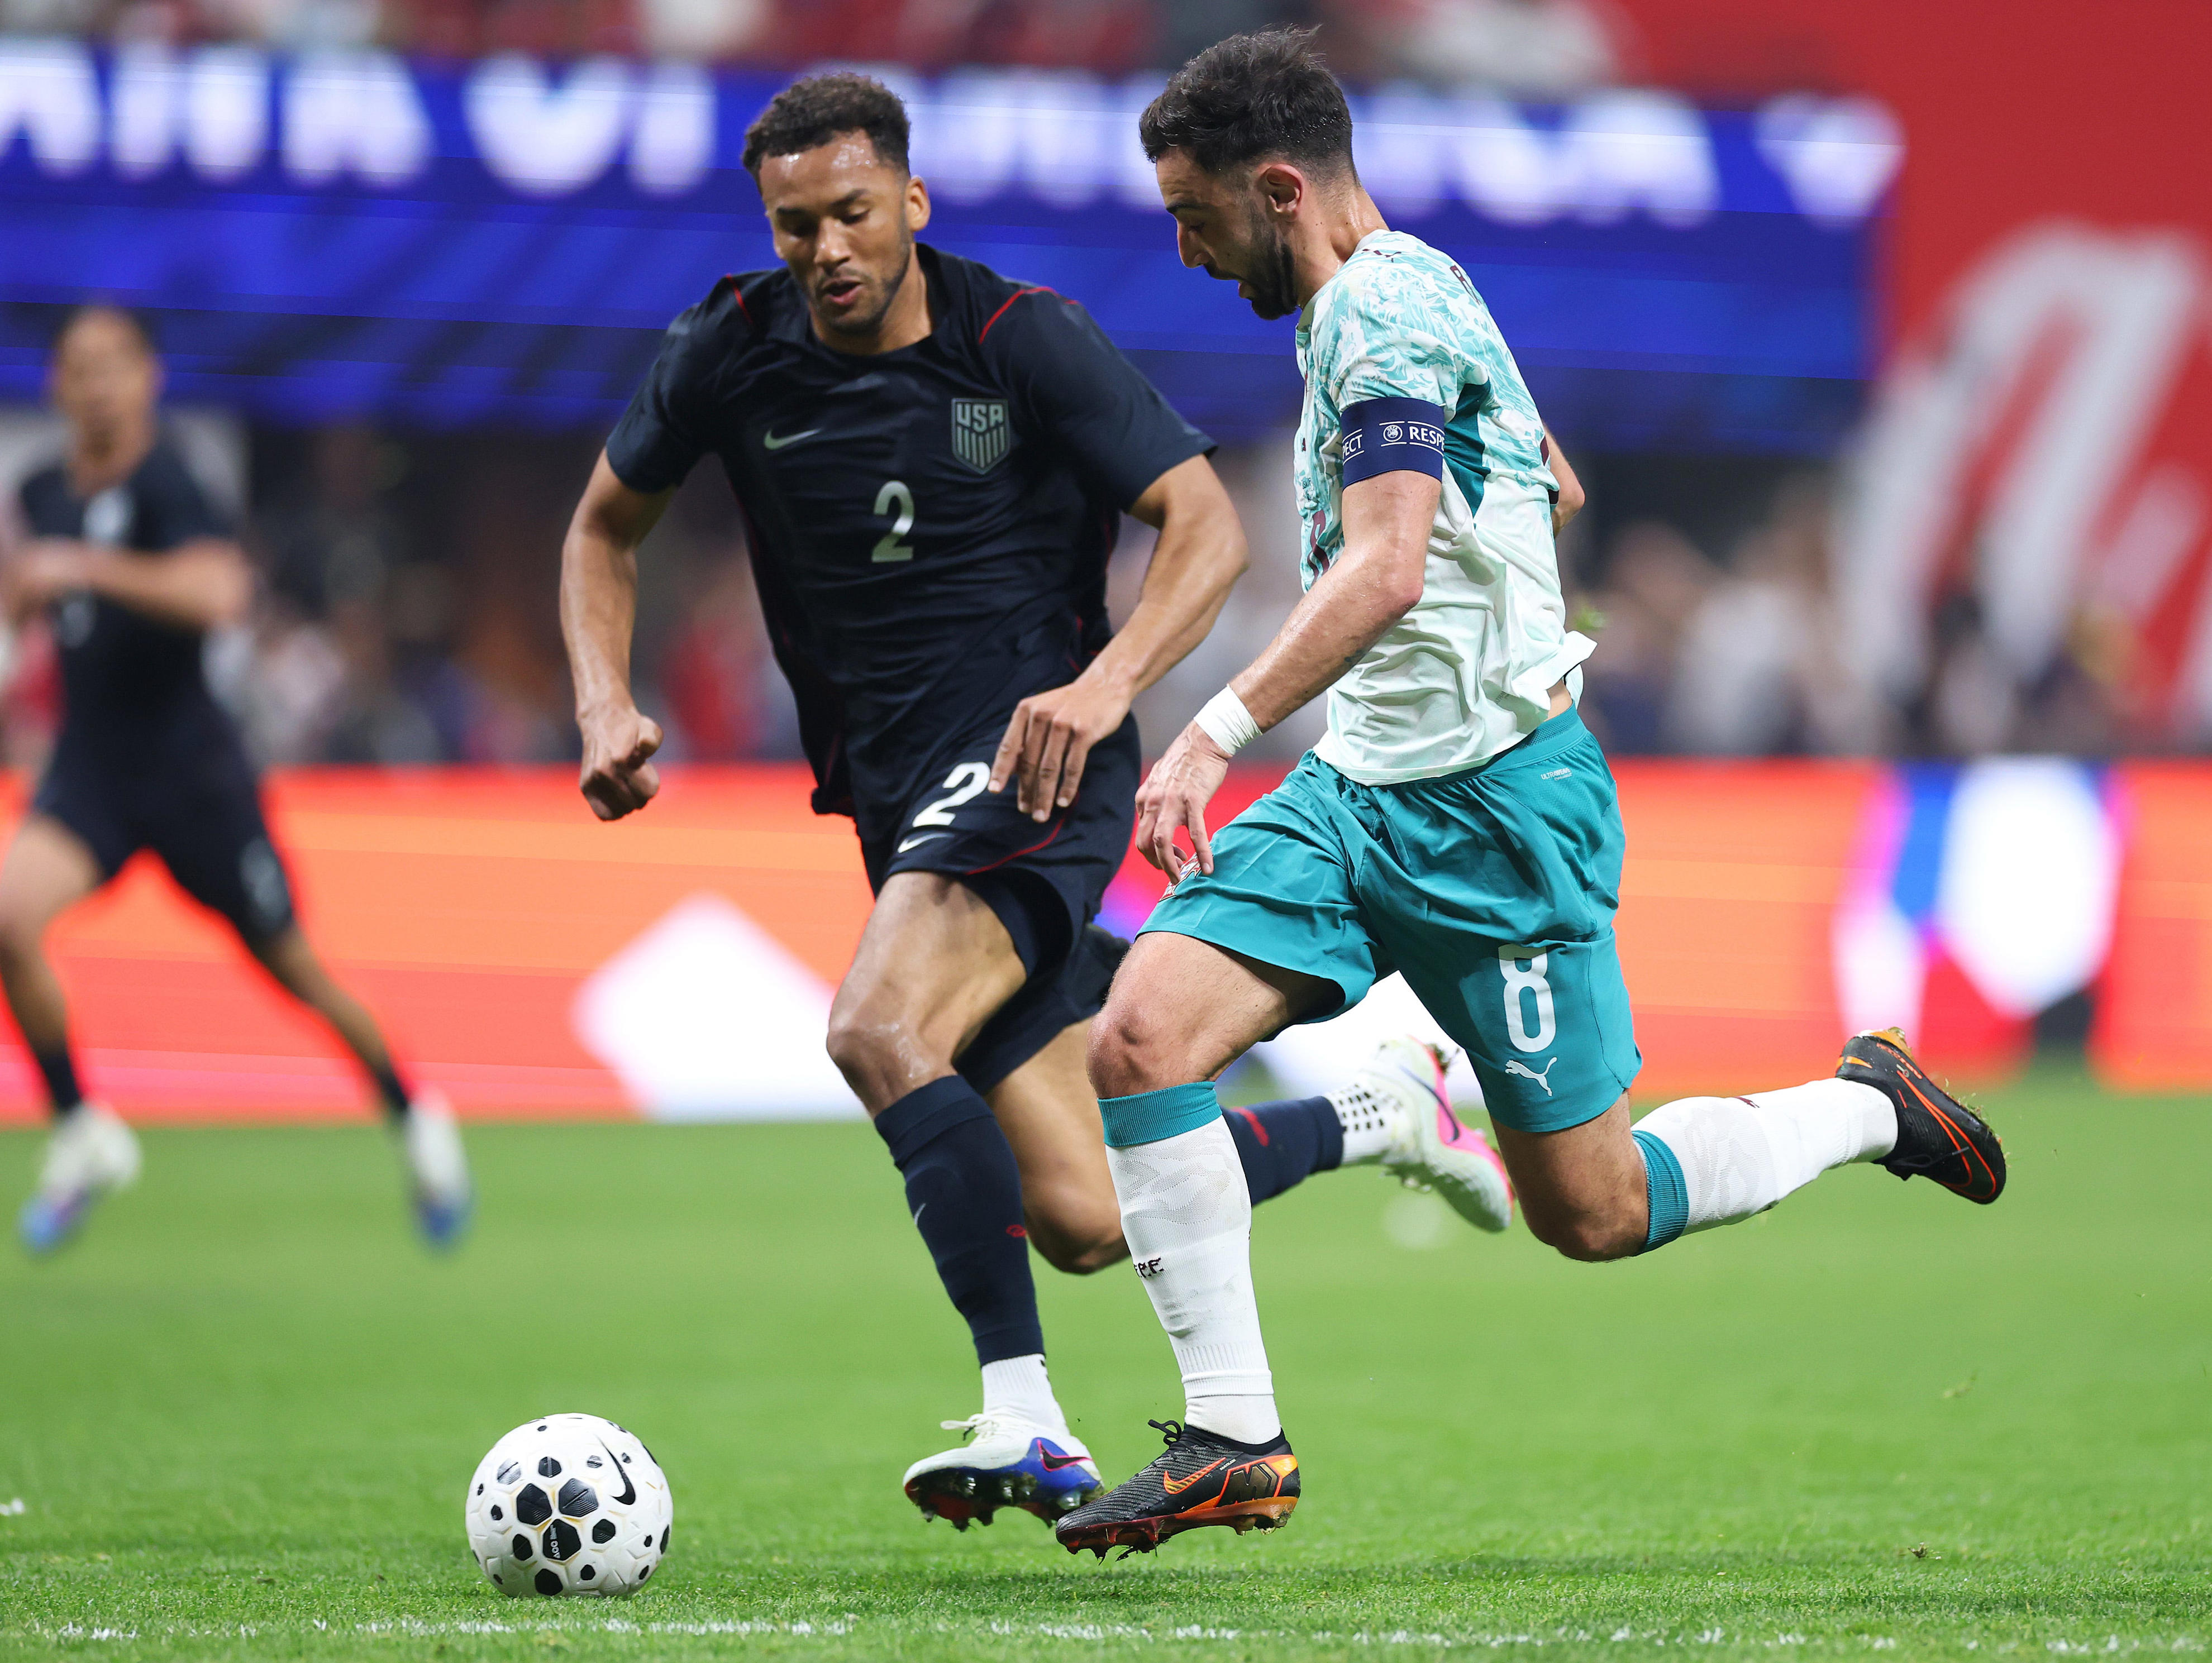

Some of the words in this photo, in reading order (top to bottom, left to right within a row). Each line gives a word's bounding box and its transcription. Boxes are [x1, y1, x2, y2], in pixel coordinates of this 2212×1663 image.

[956, 403, 1004, 433] USA
[871, 480, 914, 563] 2
[912, 761, 991, 828] 2
[1498, 943, 1556, 1053] 8
